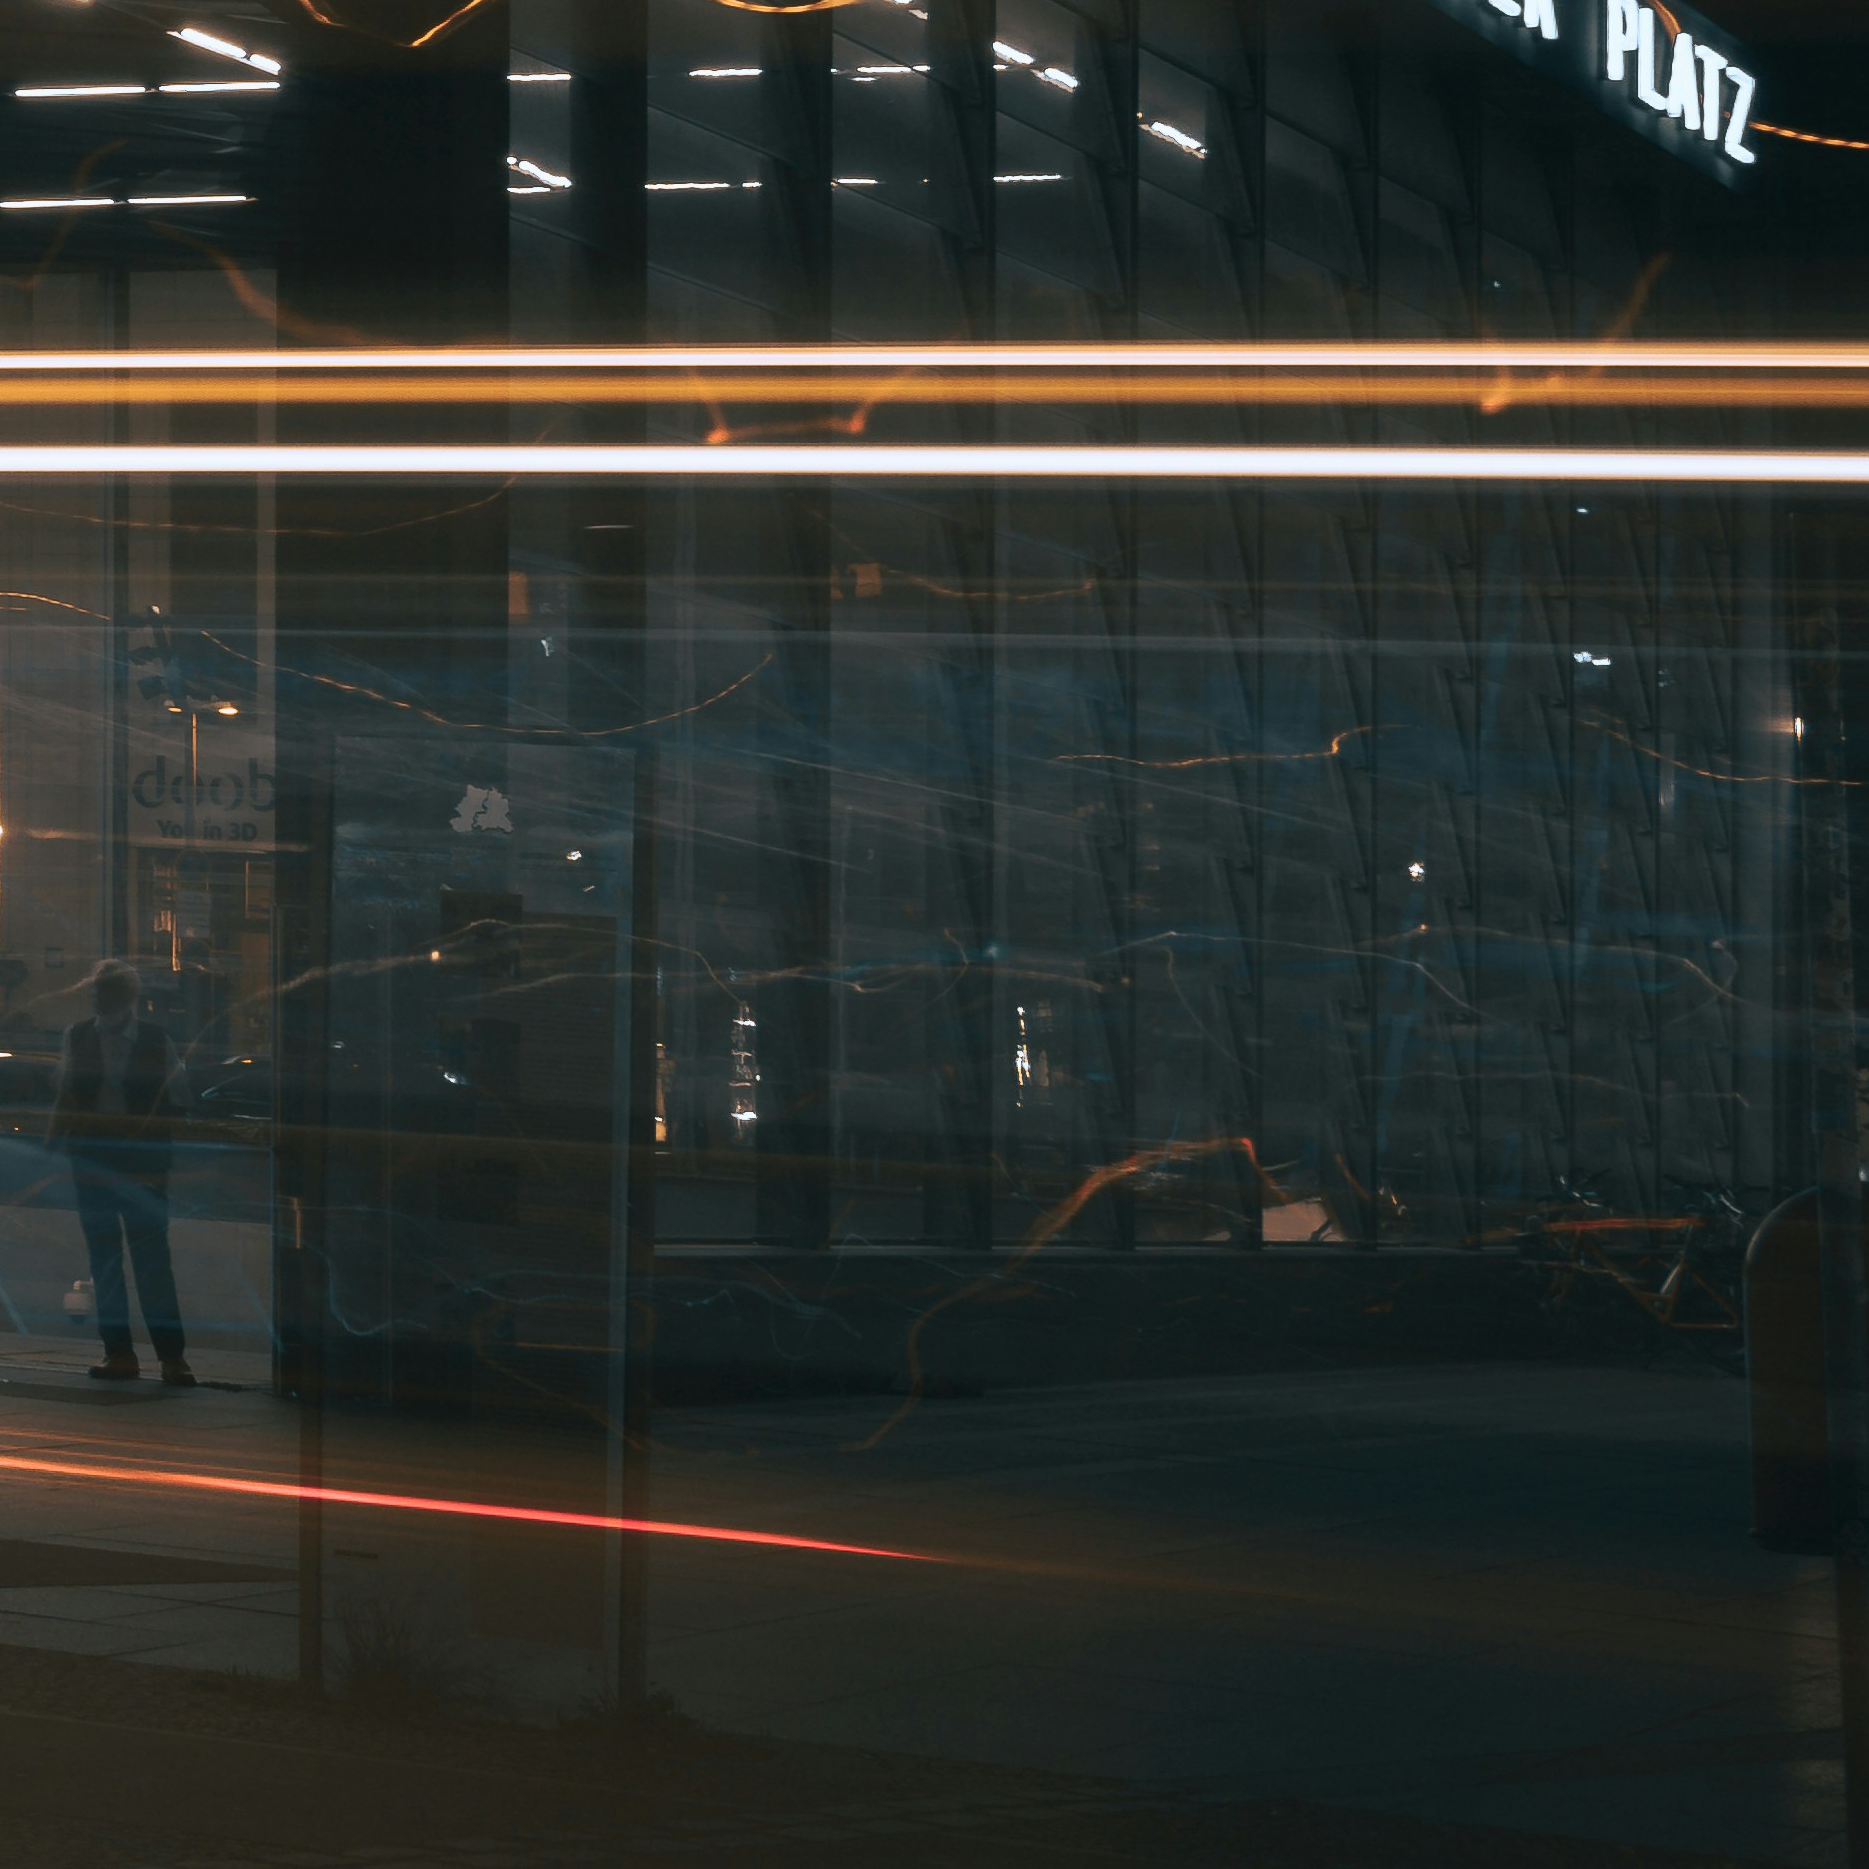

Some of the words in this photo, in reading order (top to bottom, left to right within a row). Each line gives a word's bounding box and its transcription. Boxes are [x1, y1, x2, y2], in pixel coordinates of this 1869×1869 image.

[133, 754, 276, 813] doob
[156, 819, 196, 838] Yo
[203, 816, 222, 840] in
[229, 822, 258, 842] 3D
